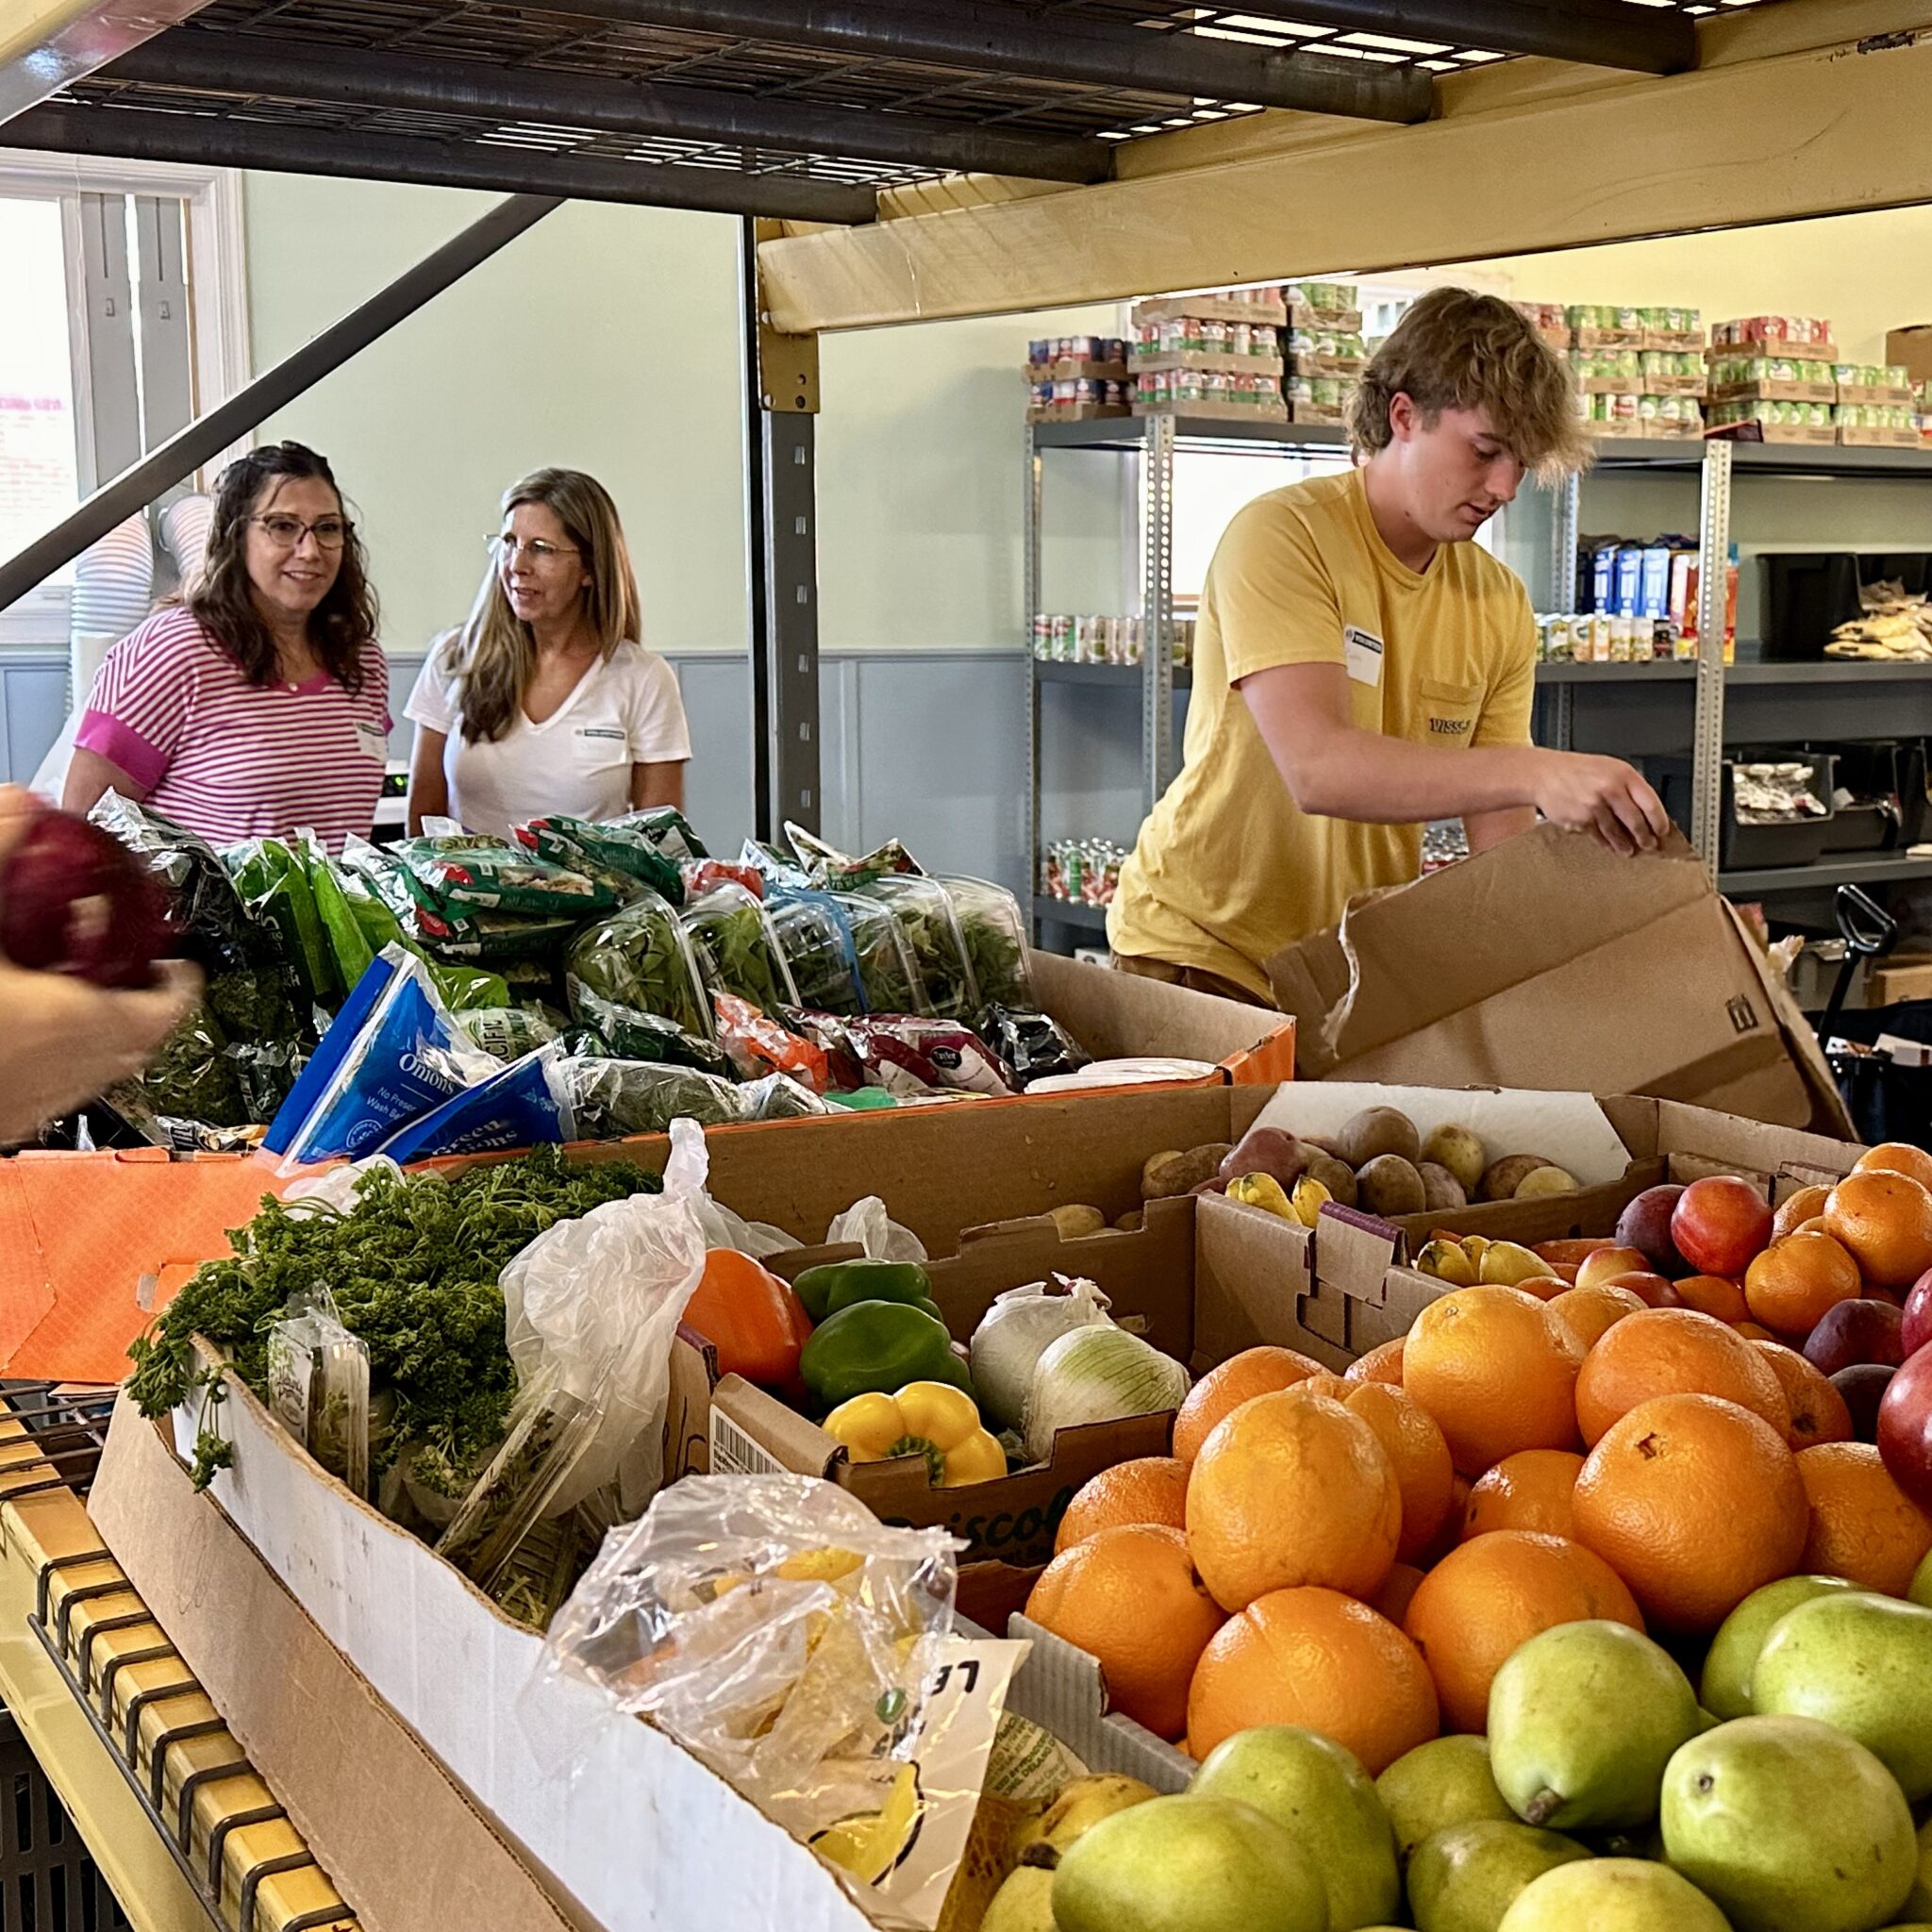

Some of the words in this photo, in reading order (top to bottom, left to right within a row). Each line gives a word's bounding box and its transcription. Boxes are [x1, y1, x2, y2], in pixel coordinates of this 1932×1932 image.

[399, 1053, 455, 1095] Onions
[377, 1087, 389, 1100] No
[366, 1095, 389, 1114] Wash
